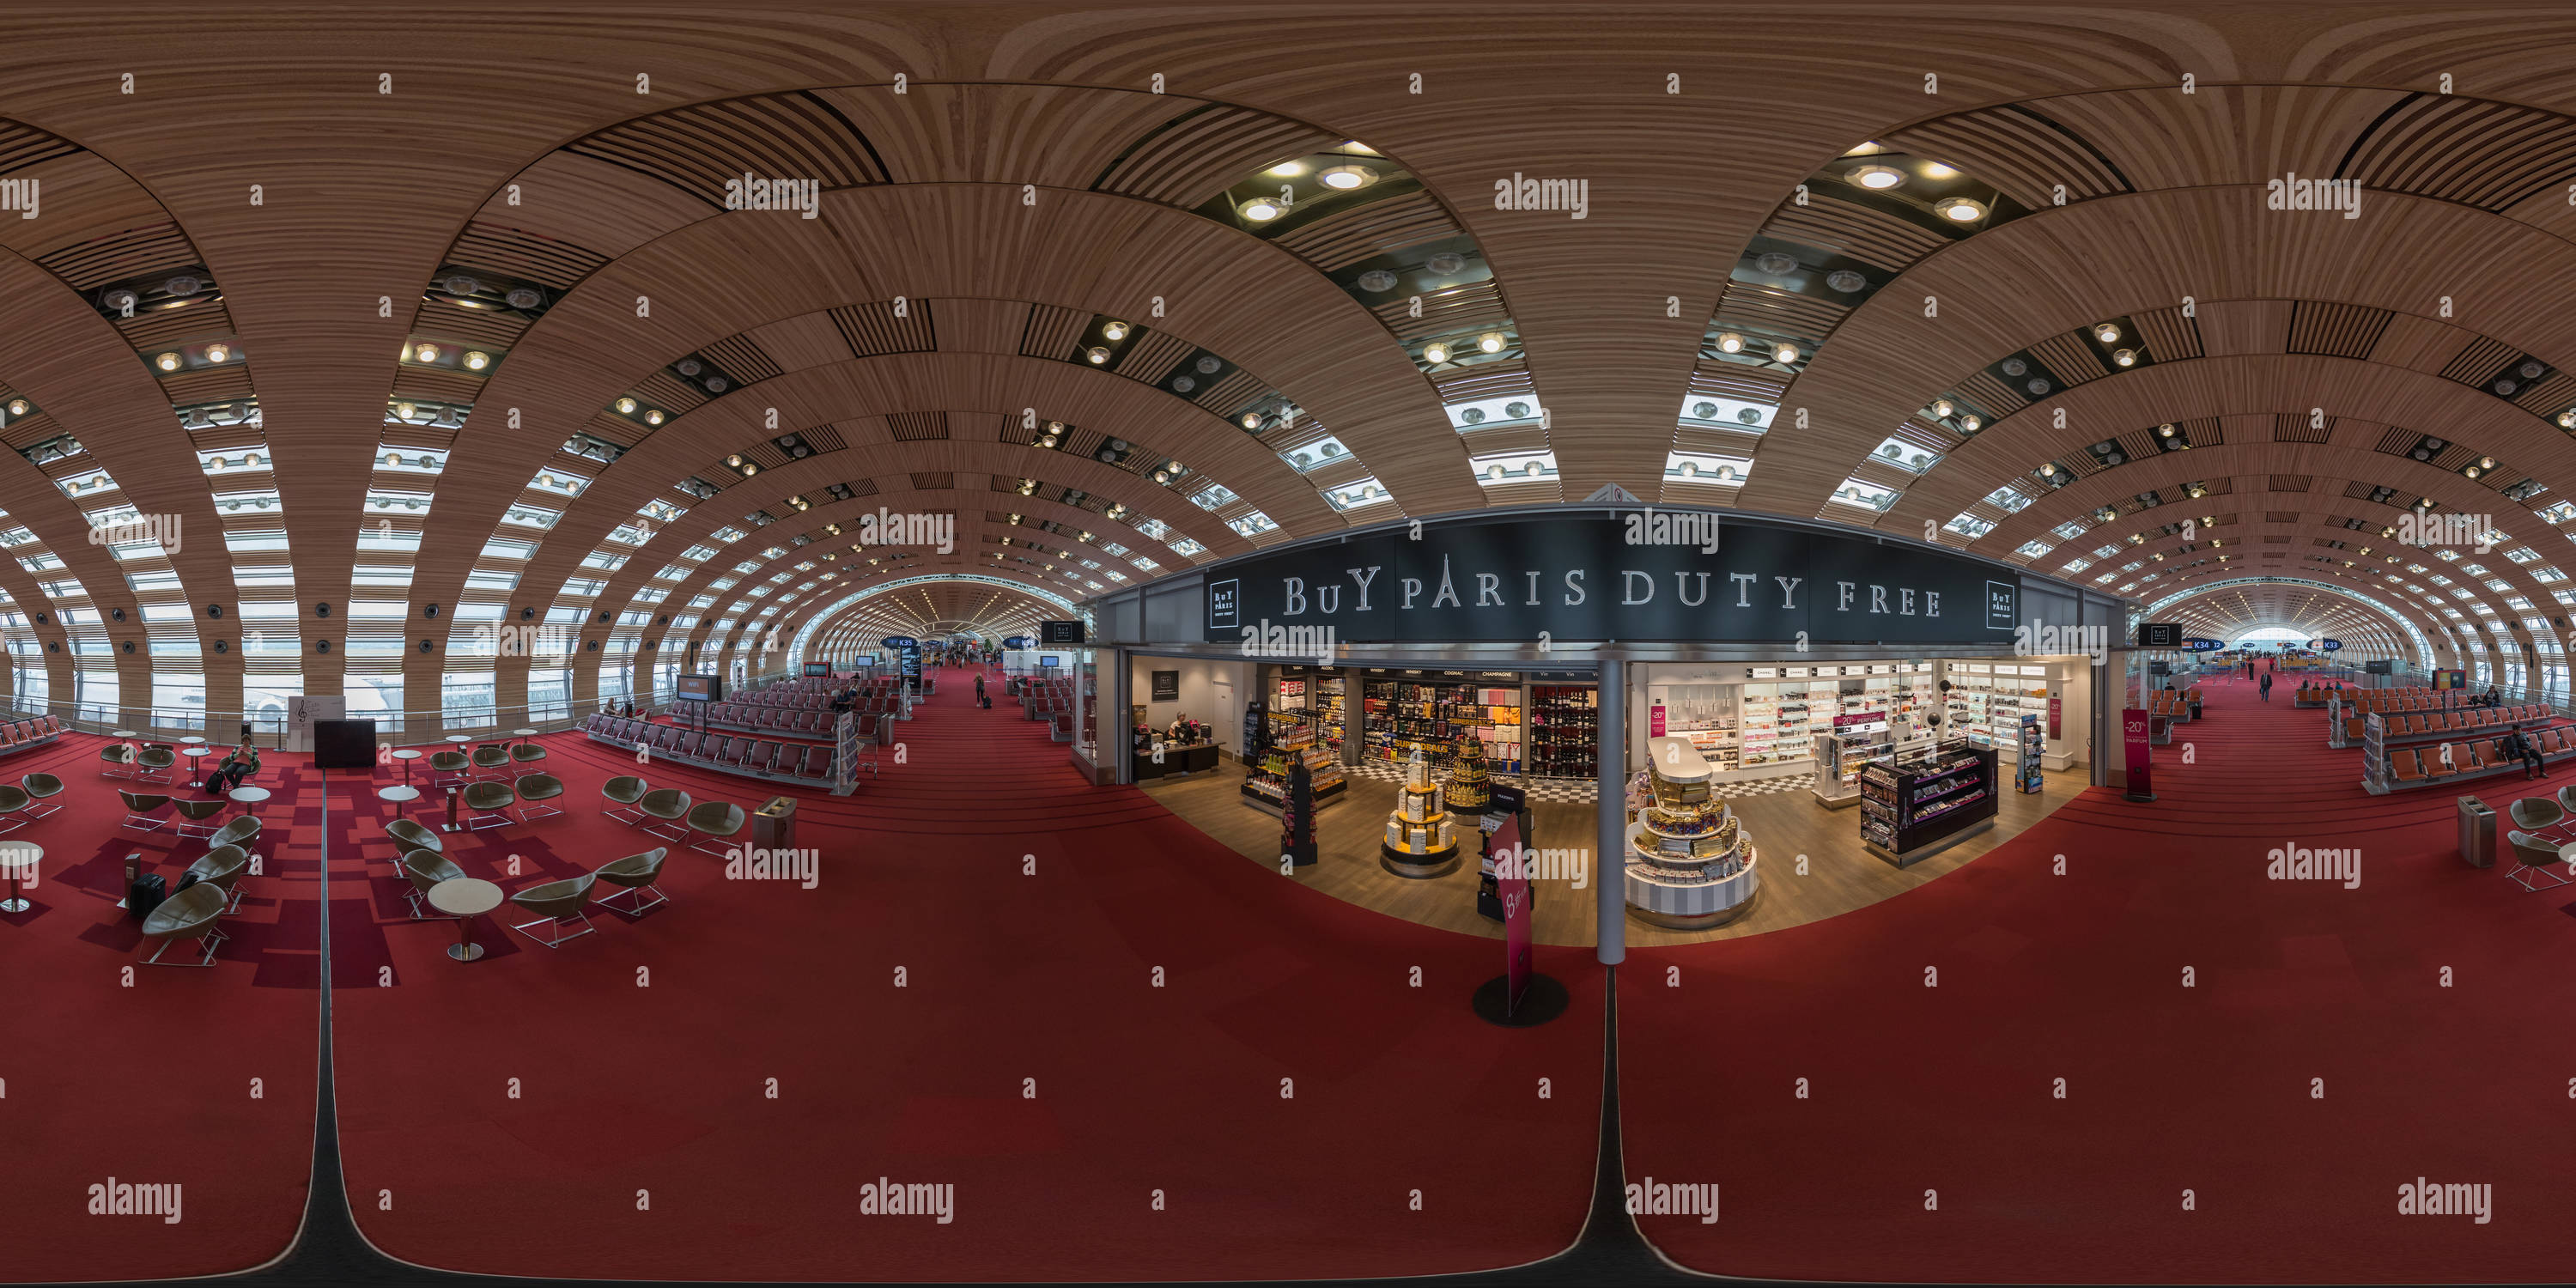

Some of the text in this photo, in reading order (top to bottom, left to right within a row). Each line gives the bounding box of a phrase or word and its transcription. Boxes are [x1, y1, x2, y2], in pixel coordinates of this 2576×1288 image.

[1401, 553, 1586, 609] PARIS
[1621, 569, 1803, 609] DUTY
[1837, 581, 1941, 617] FREE
